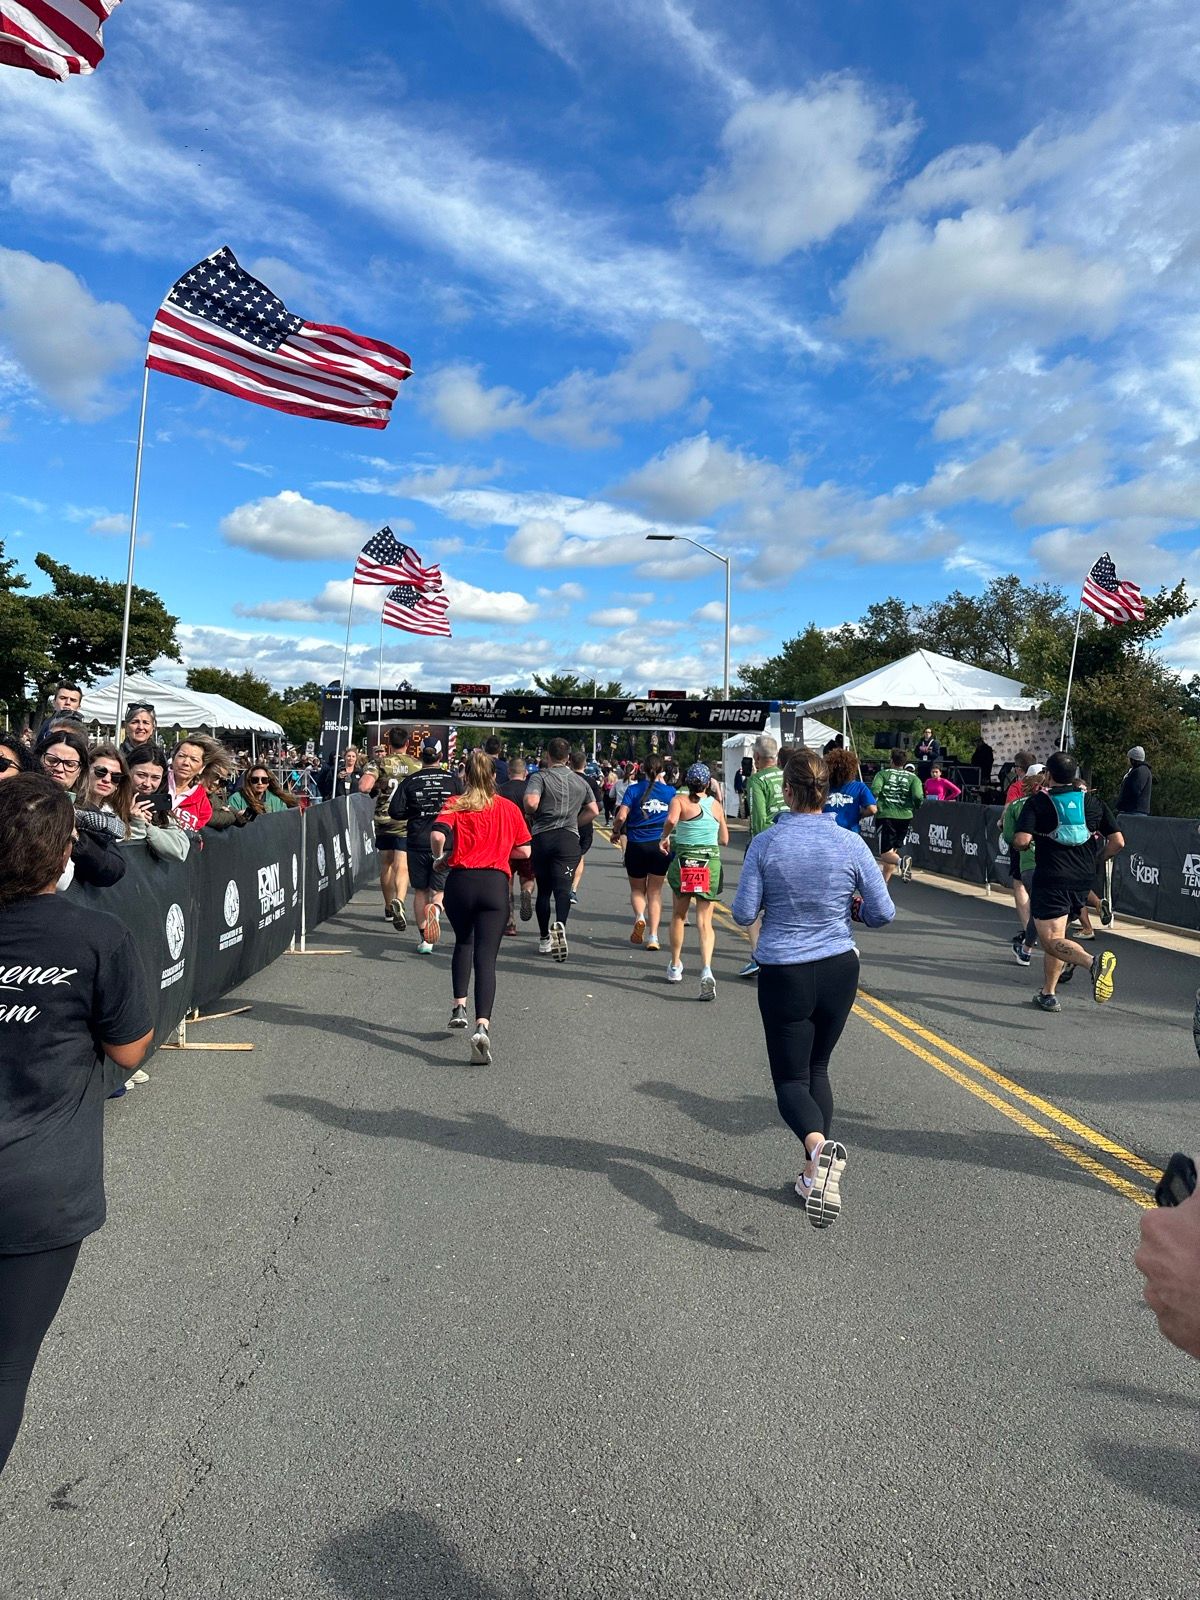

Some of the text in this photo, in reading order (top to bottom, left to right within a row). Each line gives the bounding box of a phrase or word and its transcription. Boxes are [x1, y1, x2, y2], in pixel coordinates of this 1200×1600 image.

[360, 698, 417, 713] FINISH
[451, 697, 500, 709] ARMY
[626, 702, 673, 712] ARMY
[539, 705, 594, 717] FINISH
[709, 709, 762, 723] FINISH
[257, 862, 280, 900] ARMY
[684, 873, 705, 882] 7741
[1136, 865, 1160, 885] KBR
